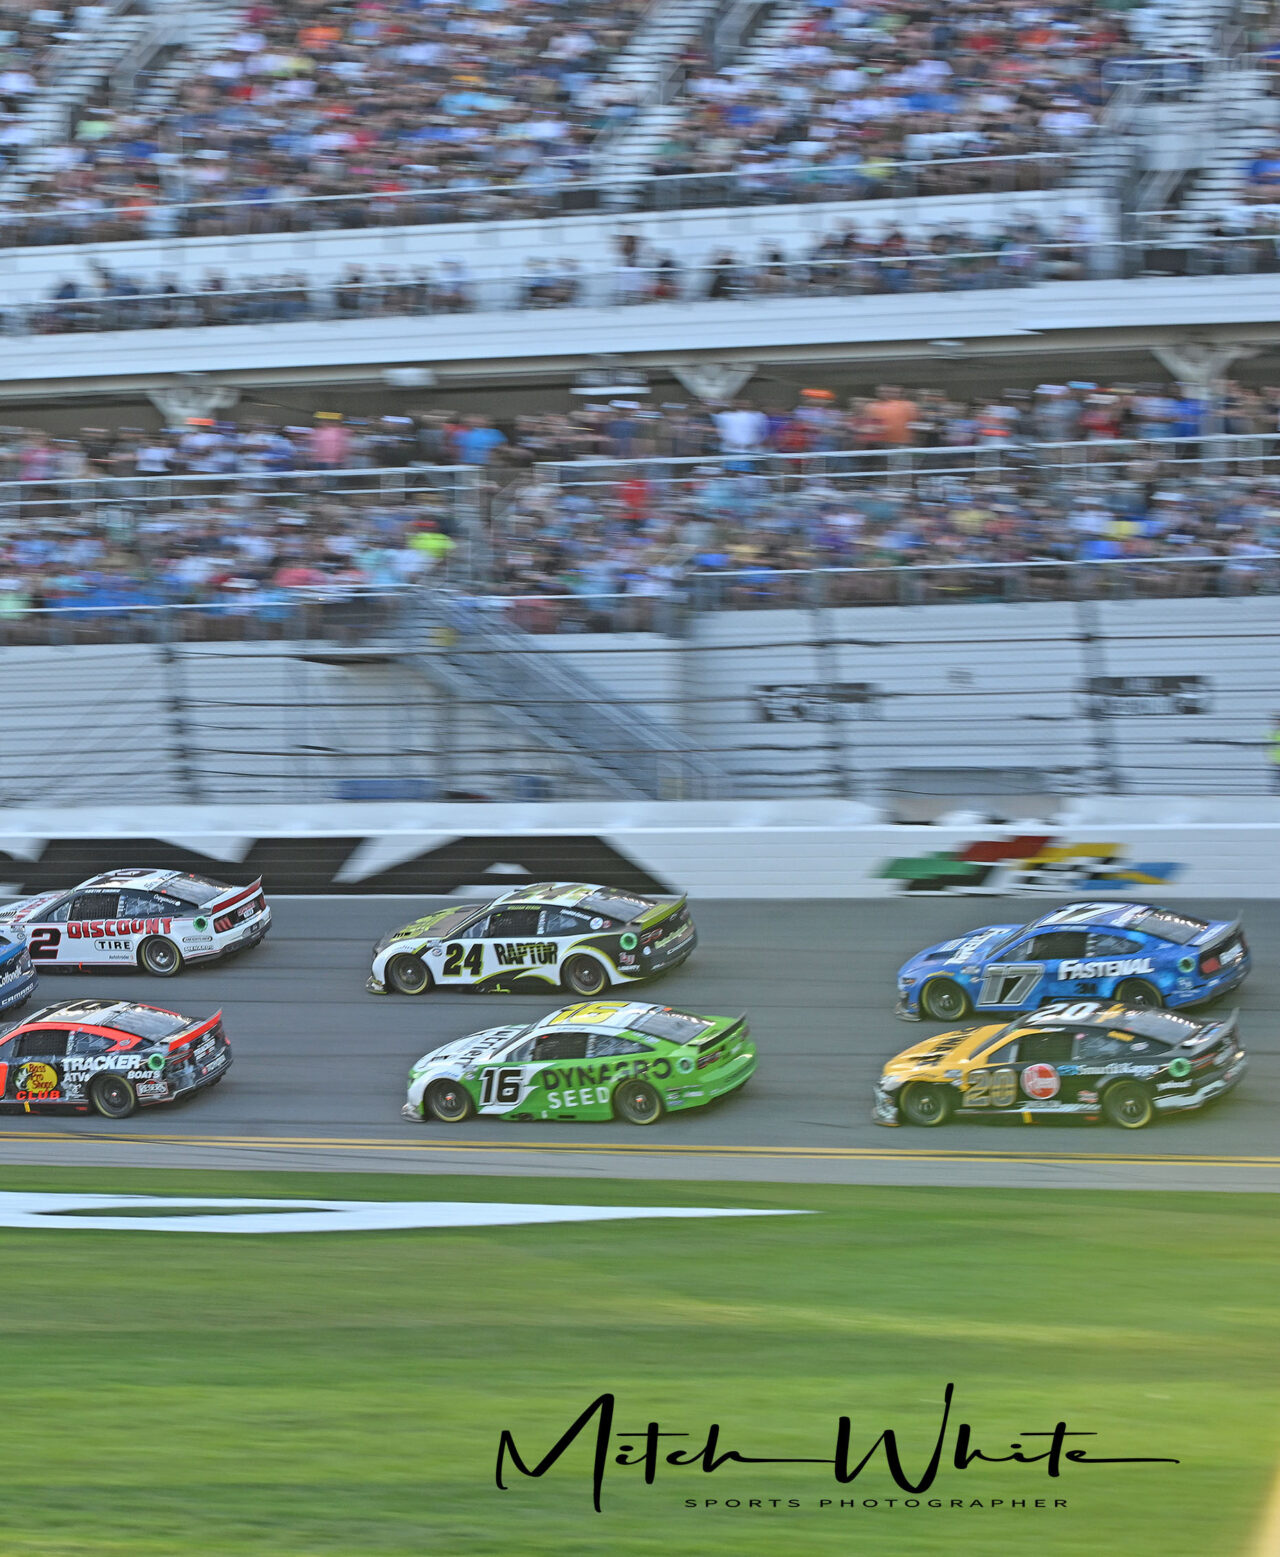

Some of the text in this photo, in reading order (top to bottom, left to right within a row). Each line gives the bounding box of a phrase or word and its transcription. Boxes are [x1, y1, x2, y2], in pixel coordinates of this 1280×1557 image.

[67, 917, 173, 939] DISCOUNT
[29, 927, 62, 960] 2
[98, 940, 131, 950] TIRE
[493, 941, 558, 966] RAPTOR
[442, 943, 485, 978] 24
[1058, 957, 1156, 981] FASTENAL
[977, 963, 1046, 1007] 17
[1024, 1002, 1101, 1023] 20
[28, 1063, 47, 1074] Bass
[61, 1054, 143, 1072] TRACKER
[127, 1069, 161, 1080] BOATS
[16, 1089, 61, 1101] CLUB
[479, 1067, 526, 1107] 16
[547, 1086, 611, 1110] SEED
